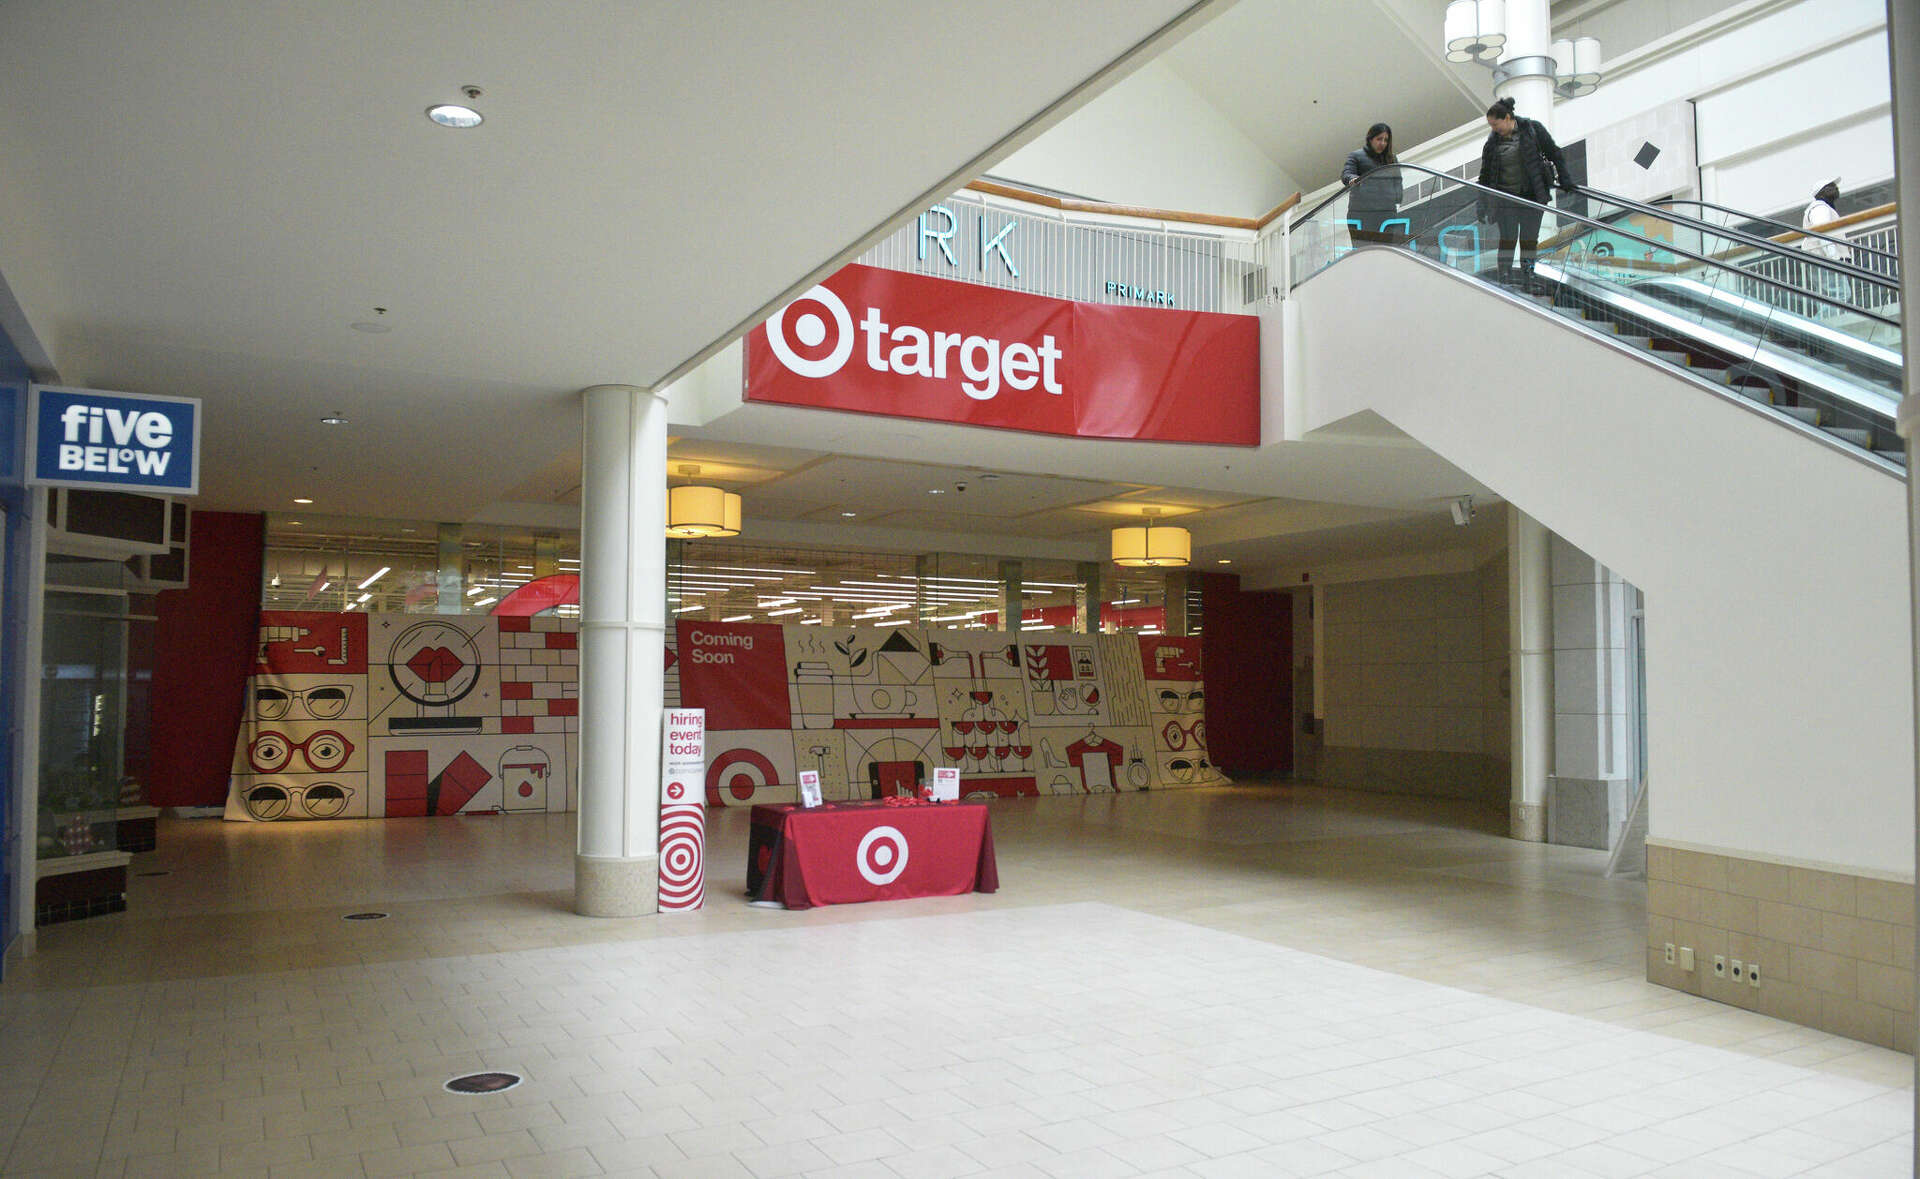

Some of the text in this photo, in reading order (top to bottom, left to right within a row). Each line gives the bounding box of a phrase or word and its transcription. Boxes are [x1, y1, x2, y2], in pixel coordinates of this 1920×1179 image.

[1105, 280, 1176, 306] PRIMARK
[860, 307, 1063, 400] target
[60, 404, 174, 449] five
[690, 630, 754, 650] Coming
[691, 648, 735, 664] Soon
[670, 712, 703, 728] hiring
[669, 743, 702, 757] today
